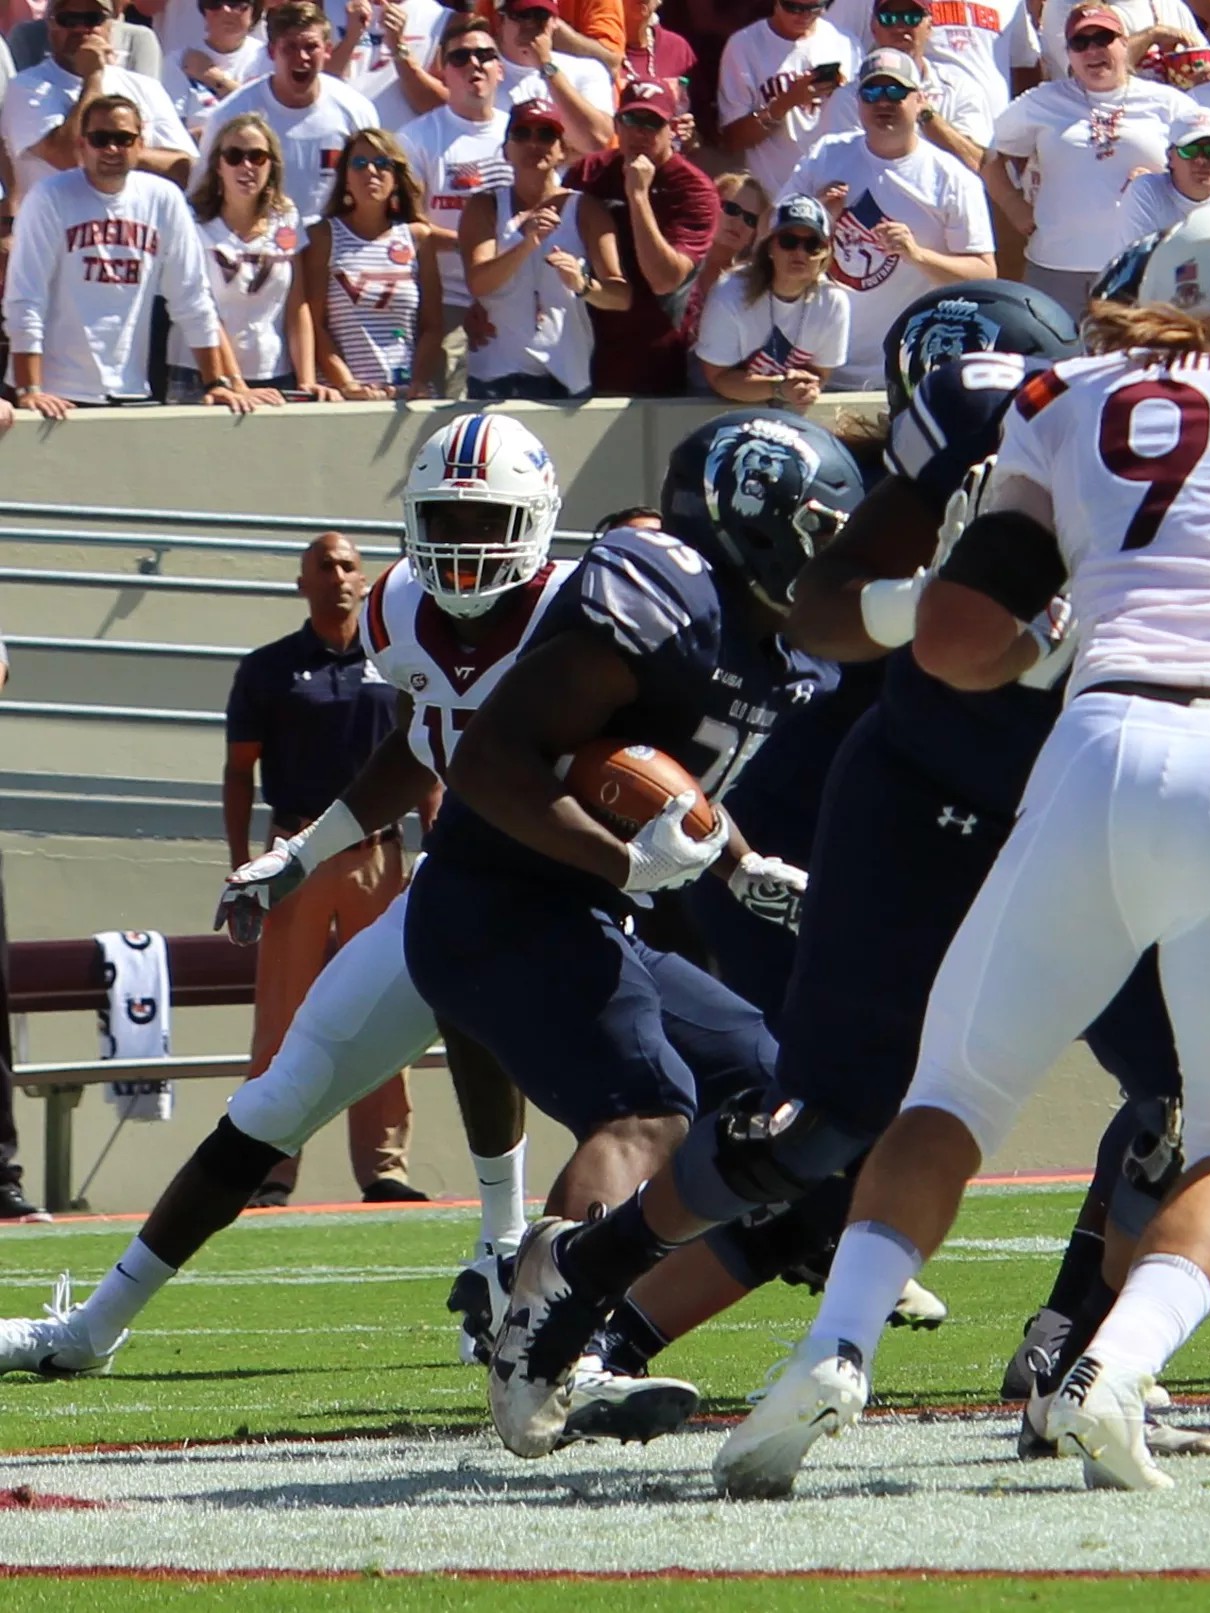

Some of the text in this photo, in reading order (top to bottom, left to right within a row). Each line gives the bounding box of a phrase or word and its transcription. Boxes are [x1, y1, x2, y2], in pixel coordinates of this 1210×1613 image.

[632, 83, 664, 98] VT
[66, 219, 159, 256] VIRGINIA
[82, 256, 140, 284] TECH
[210, 248, 293, 293] VT
[334, 271, 413, 308] VT
[454, 667, 475, 680] VT
[1061, 1355, 1103, 1408] NIKE
